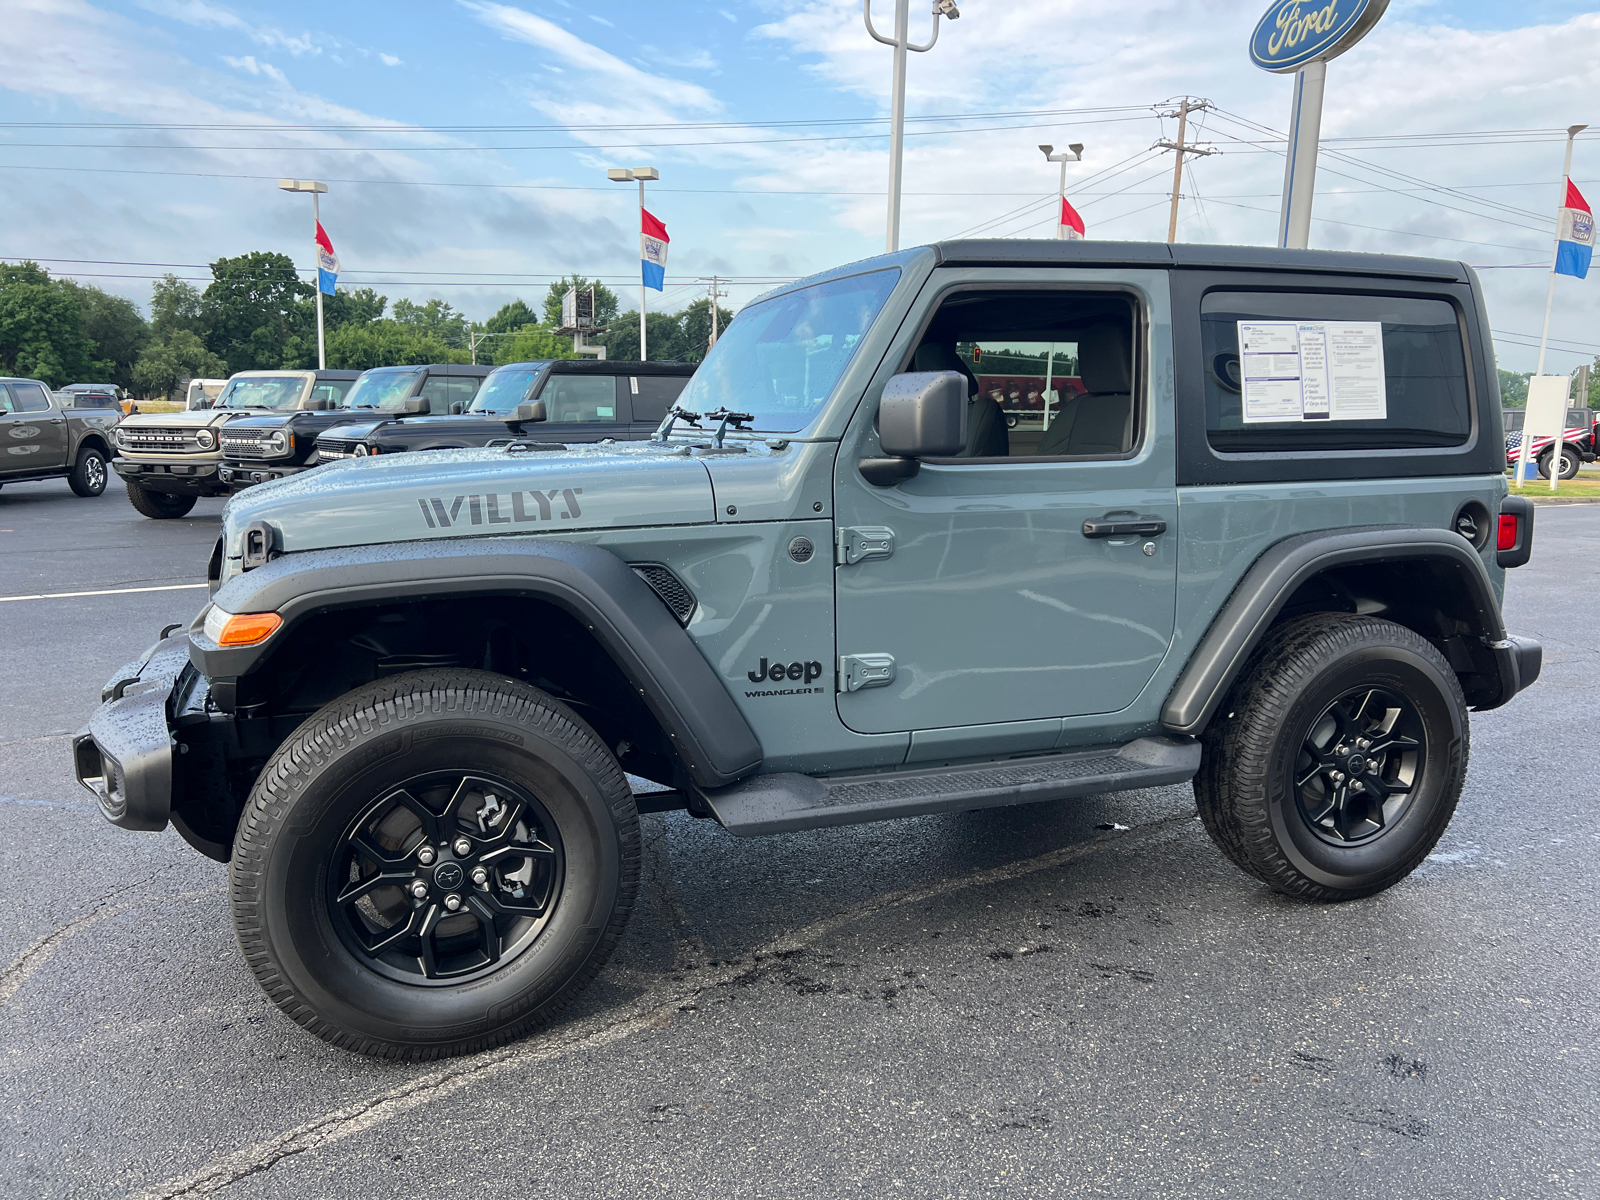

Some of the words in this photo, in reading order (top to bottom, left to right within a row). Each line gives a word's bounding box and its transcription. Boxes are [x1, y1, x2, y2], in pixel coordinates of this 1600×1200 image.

[1268, 0, 1339, 56] Ford
[417, 488, 583, 528] WILLYS
[748, 657, 822, 685] Jeep
[744, 687, 812, 698] WRANGLER
[419, 725, 472, 738] DEFENDER
